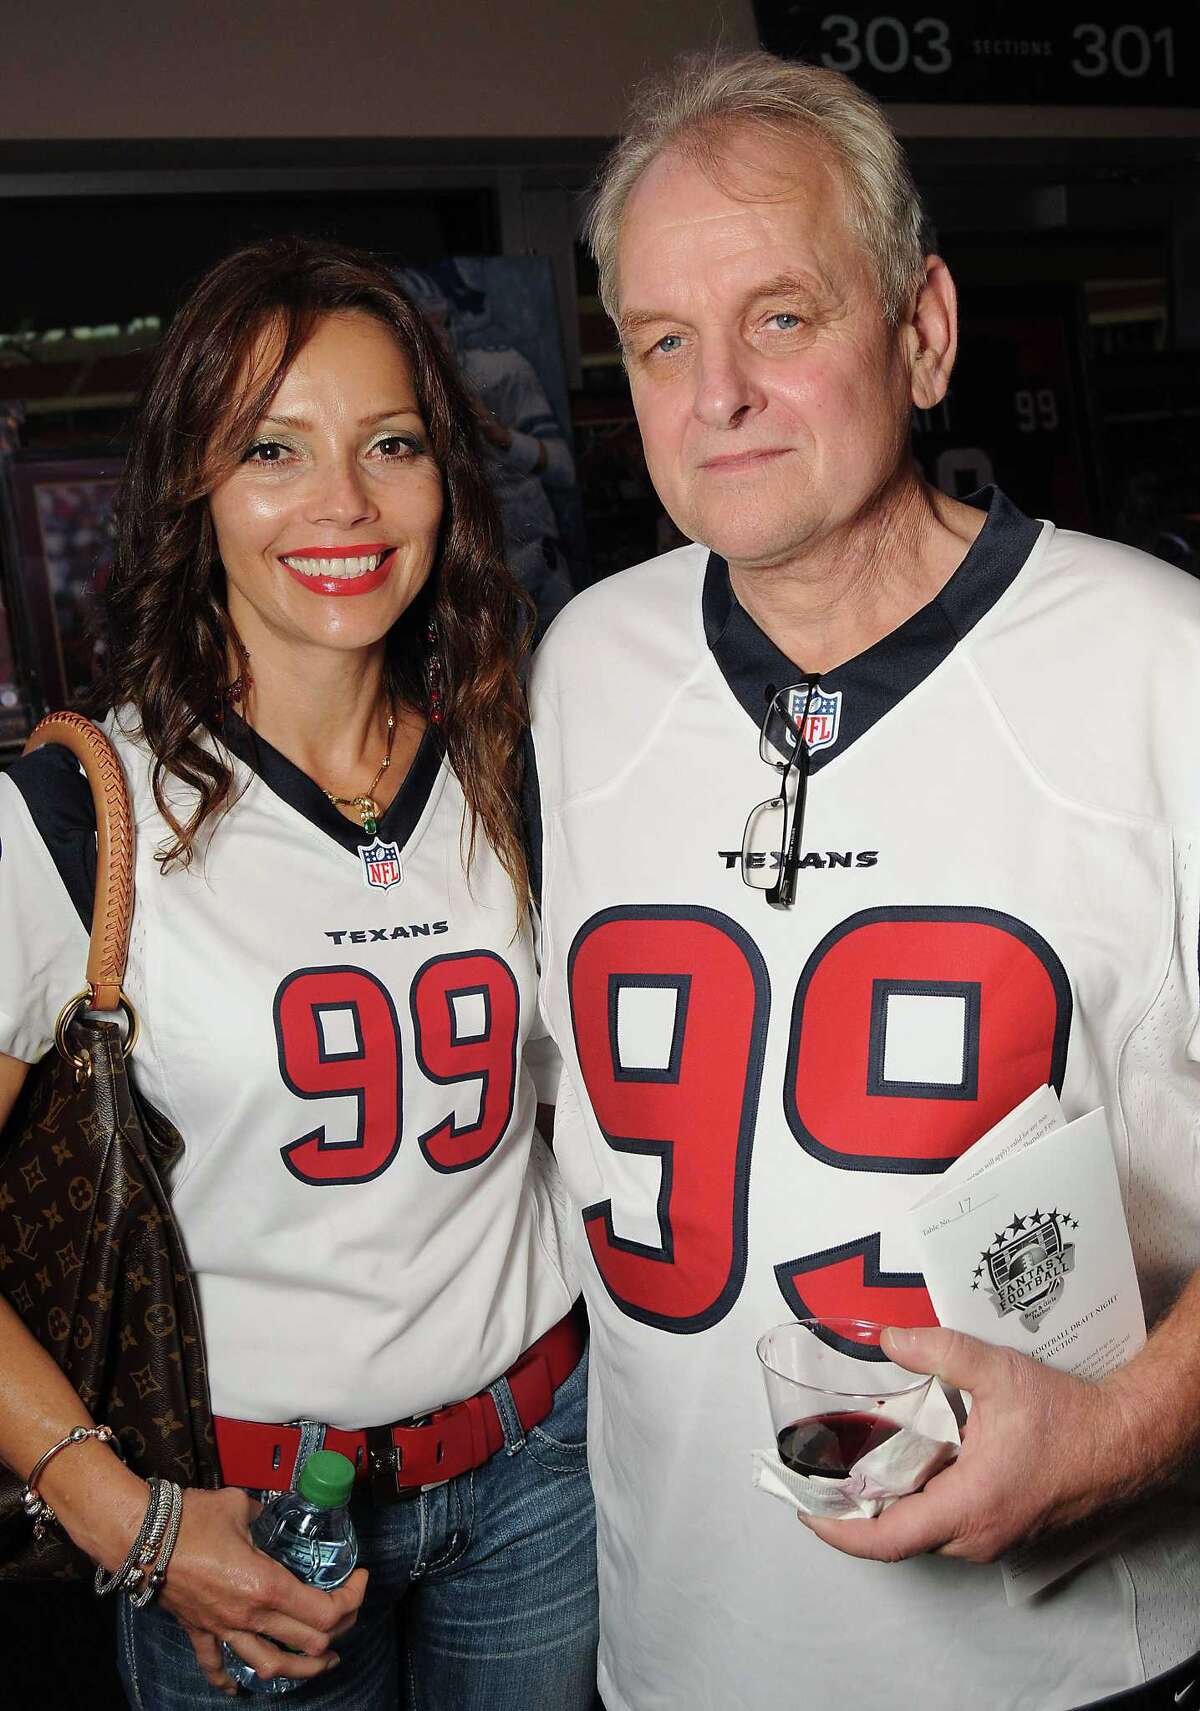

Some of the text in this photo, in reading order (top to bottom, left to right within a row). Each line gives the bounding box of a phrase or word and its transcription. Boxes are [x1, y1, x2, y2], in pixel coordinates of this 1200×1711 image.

[820, 13, 1176, 78] 303 SECTIONS 301
[1015, 389, 1058, 432] 99
[370, 862, 398, 885] NFL
[324, 921, 448, 944] TEXANS
[273, 949, 520, 1186] 99
[567, 904, 1073, 1361] 99
[958, 1197, 971, 1213] 17
[998, 1253, 1065, 1300] FANTASY
[1000, 1263, 1069, 1312] FOOTBALL
[1031, 1329, 1069, 1357] FOOTBALL
[1070, 1312, 1094, 1332] DRAFT
[1095, 1295, 1118, 1314] NIGHT
[1046, 1333, 1079, 1359] AUCTION
